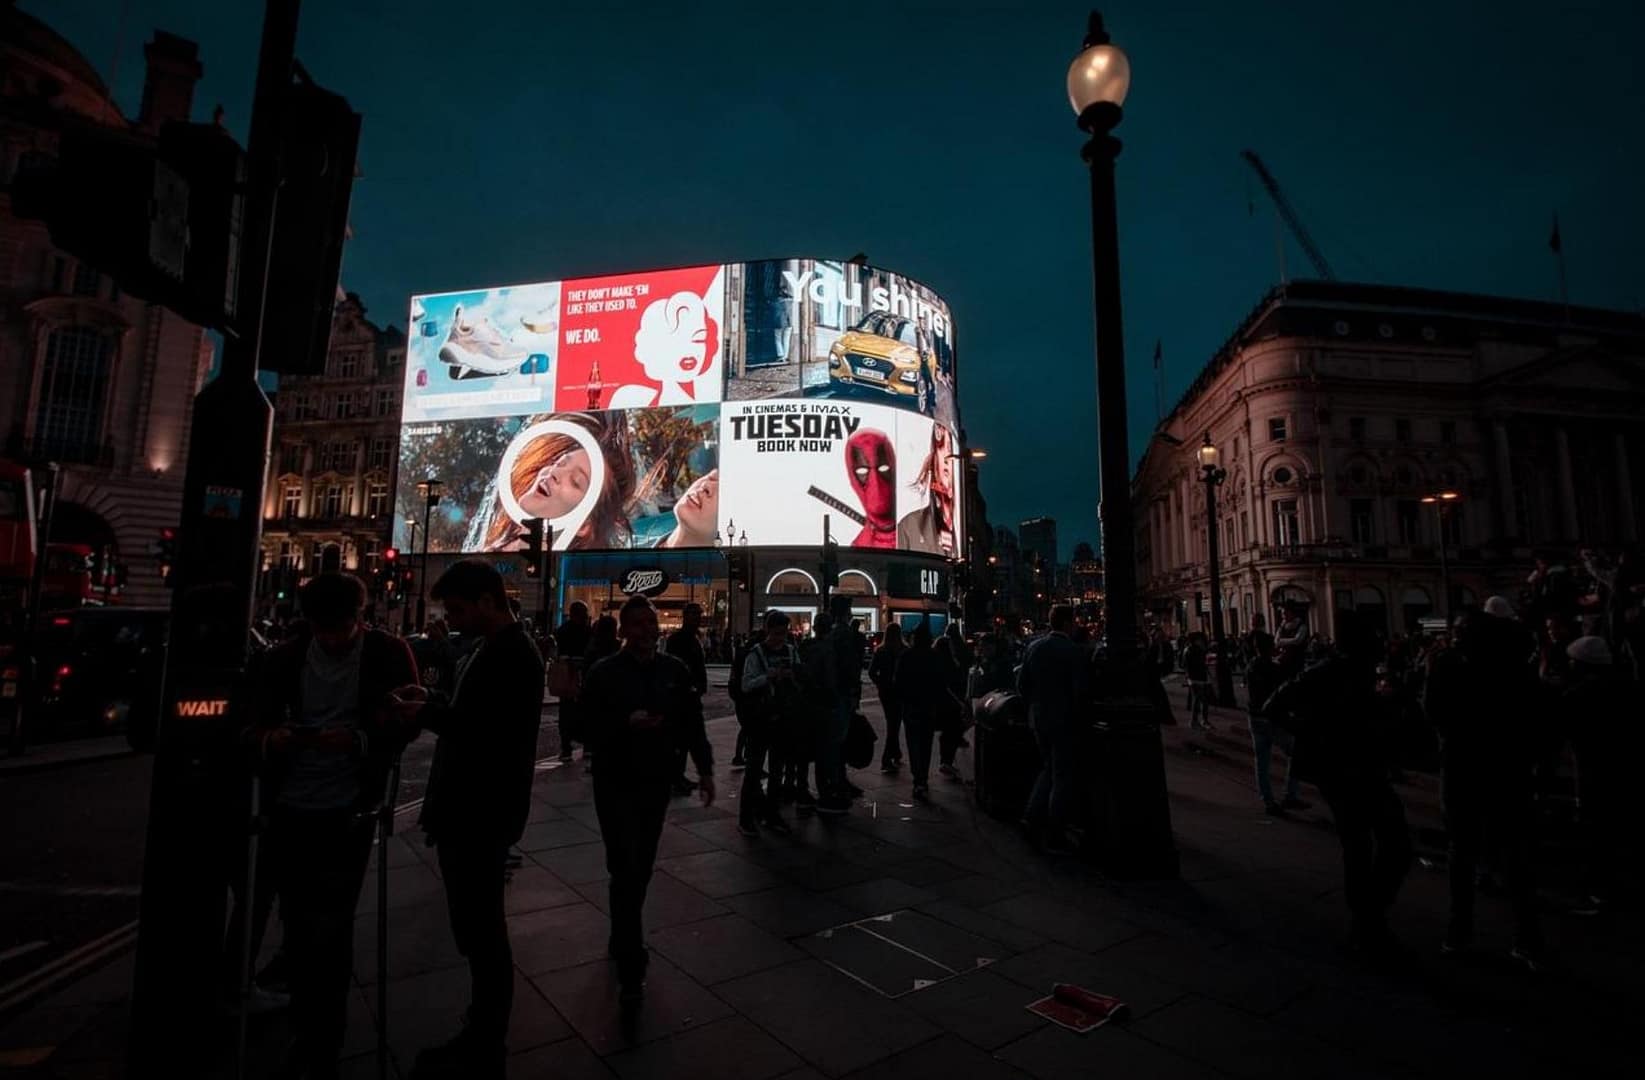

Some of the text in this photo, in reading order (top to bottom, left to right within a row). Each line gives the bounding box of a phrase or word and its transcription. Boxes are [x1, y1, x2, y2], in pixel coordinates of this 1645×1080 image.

[567, 290, 586, 303] THEY
[611, 285, 634, 298] MAKE
[783, 270, 862, 308] You
[567, 302, 585, 315] LIKE
[585, 300, 604, 313] THEY
[605, 299, 625, 312] USED
[566, 327, 601, 344] WE DO.
[743, 404, 851, 415] IN CINEMAS & IMAX
[730, 414, 861, 440] TUESDAY
[757, 440, 832, 453] BOOK NOW
[622, 569, 664, 593] Boots
[920, 568, 939, 594] GAP
[177, 700, 228, 717] WAIT
